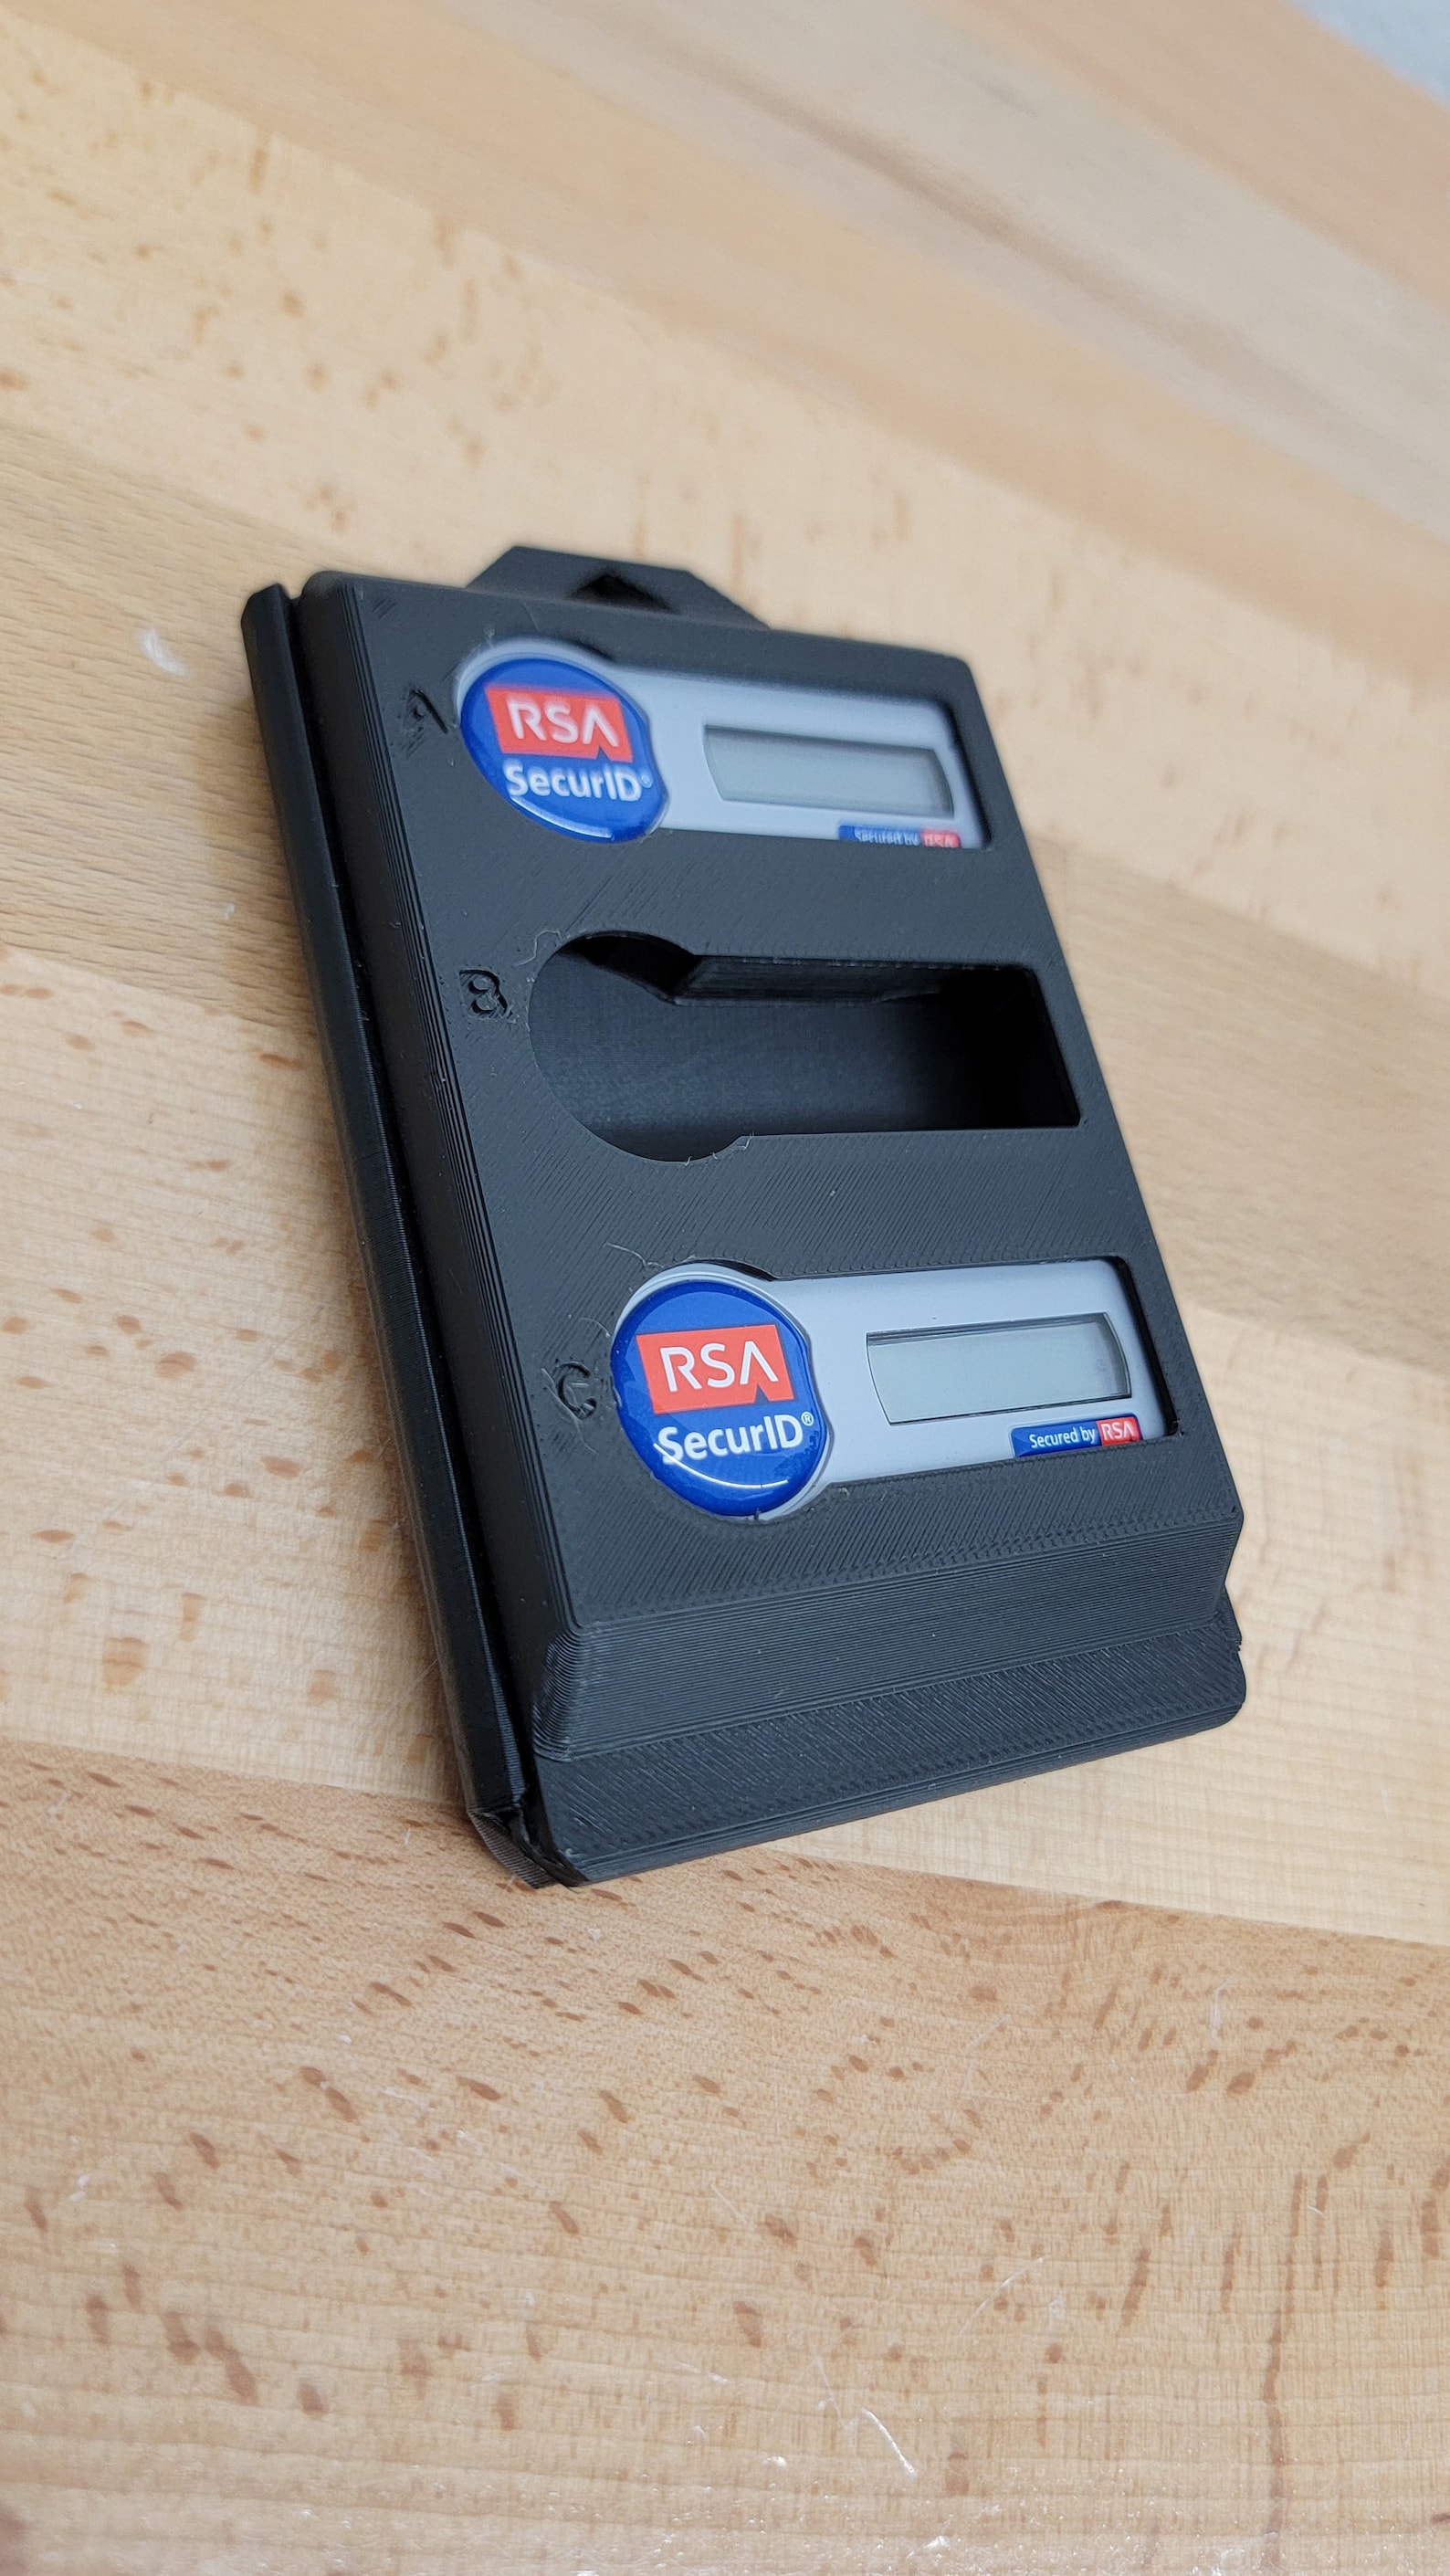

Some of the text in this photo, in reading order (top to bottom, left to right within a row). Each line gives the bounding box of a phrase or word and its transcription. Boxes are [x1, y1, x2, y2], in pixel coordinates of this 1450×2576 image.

[505, 693, 620, 748] RSA
[458, 968, 510, 1019] B
[555, 1361, 598, 1418] C
[659, 1341, 779, 1393] RSA
[1028, 1420, 1136, 1448] Secured by RSA
